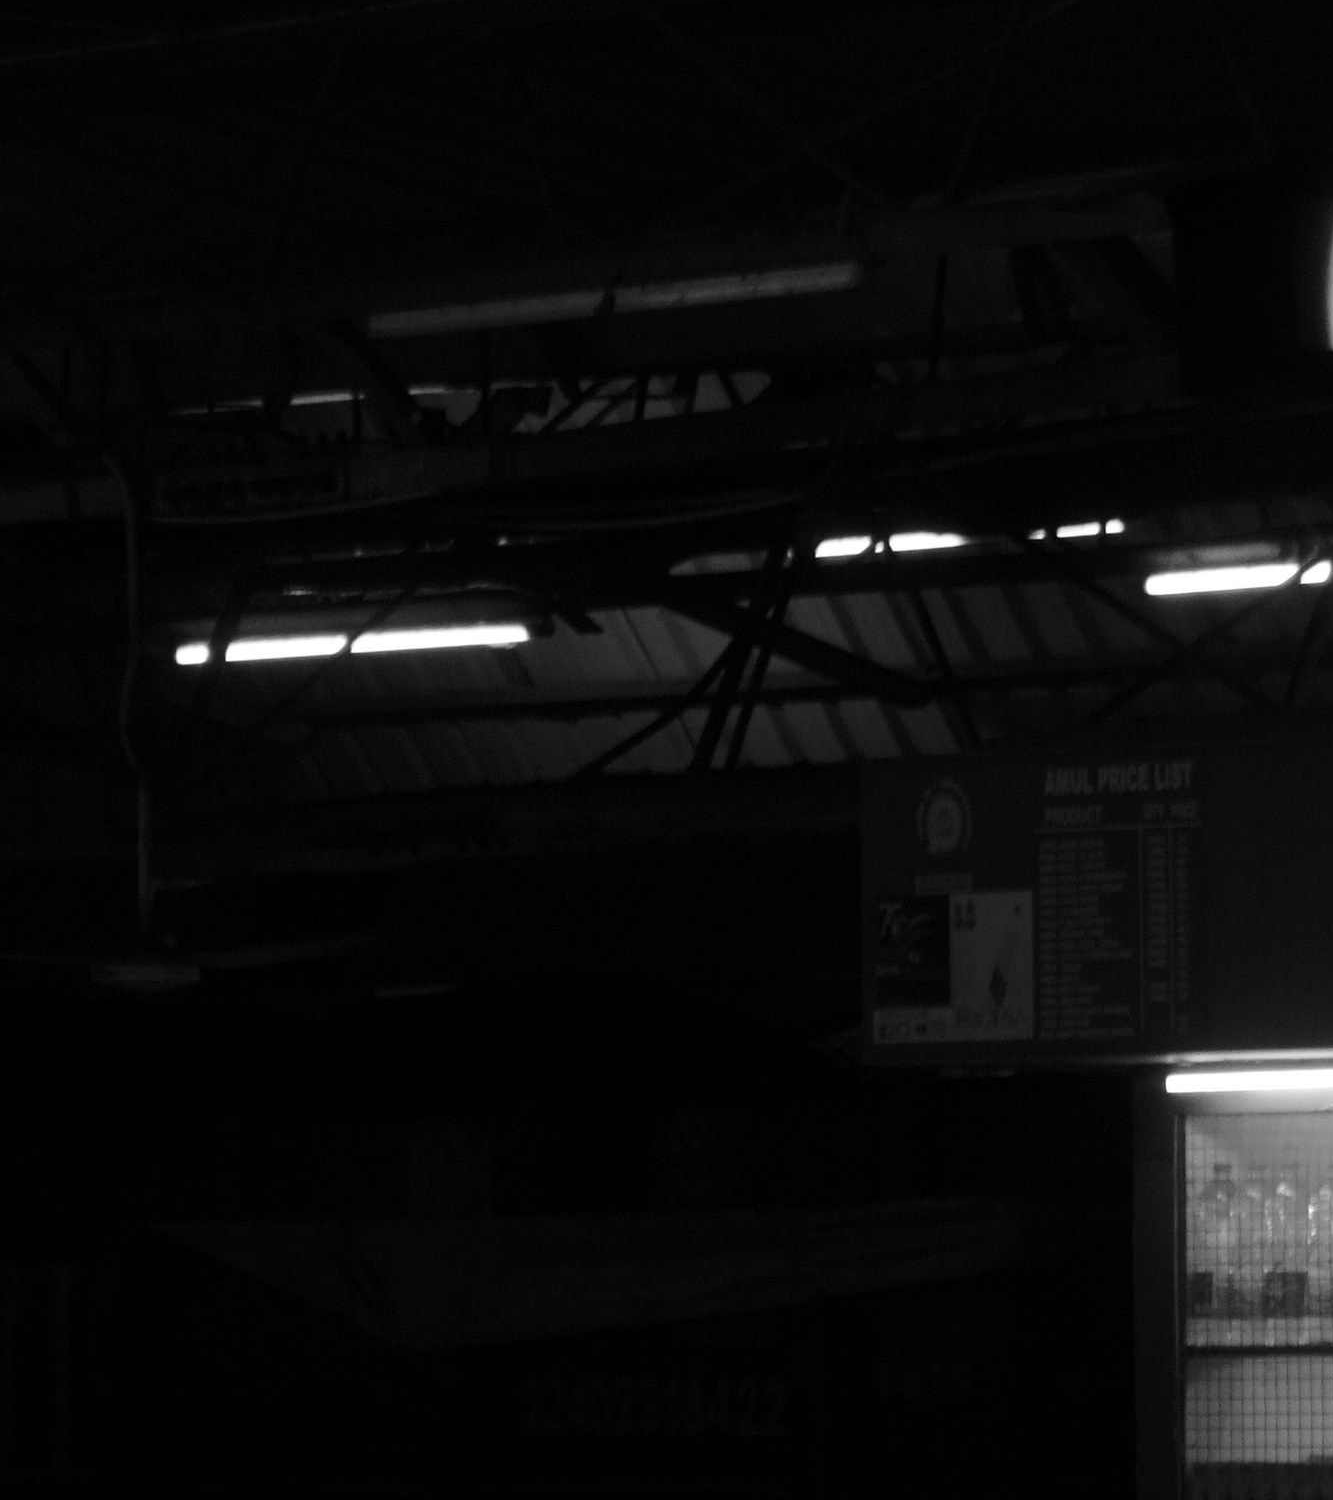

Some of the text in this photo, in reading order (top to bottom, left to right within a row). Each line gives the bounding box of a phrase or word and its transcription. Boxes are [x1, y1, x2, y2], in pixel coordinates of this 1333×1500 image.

[1043, 761, 1193, 796] AMUL PRICE LIST
